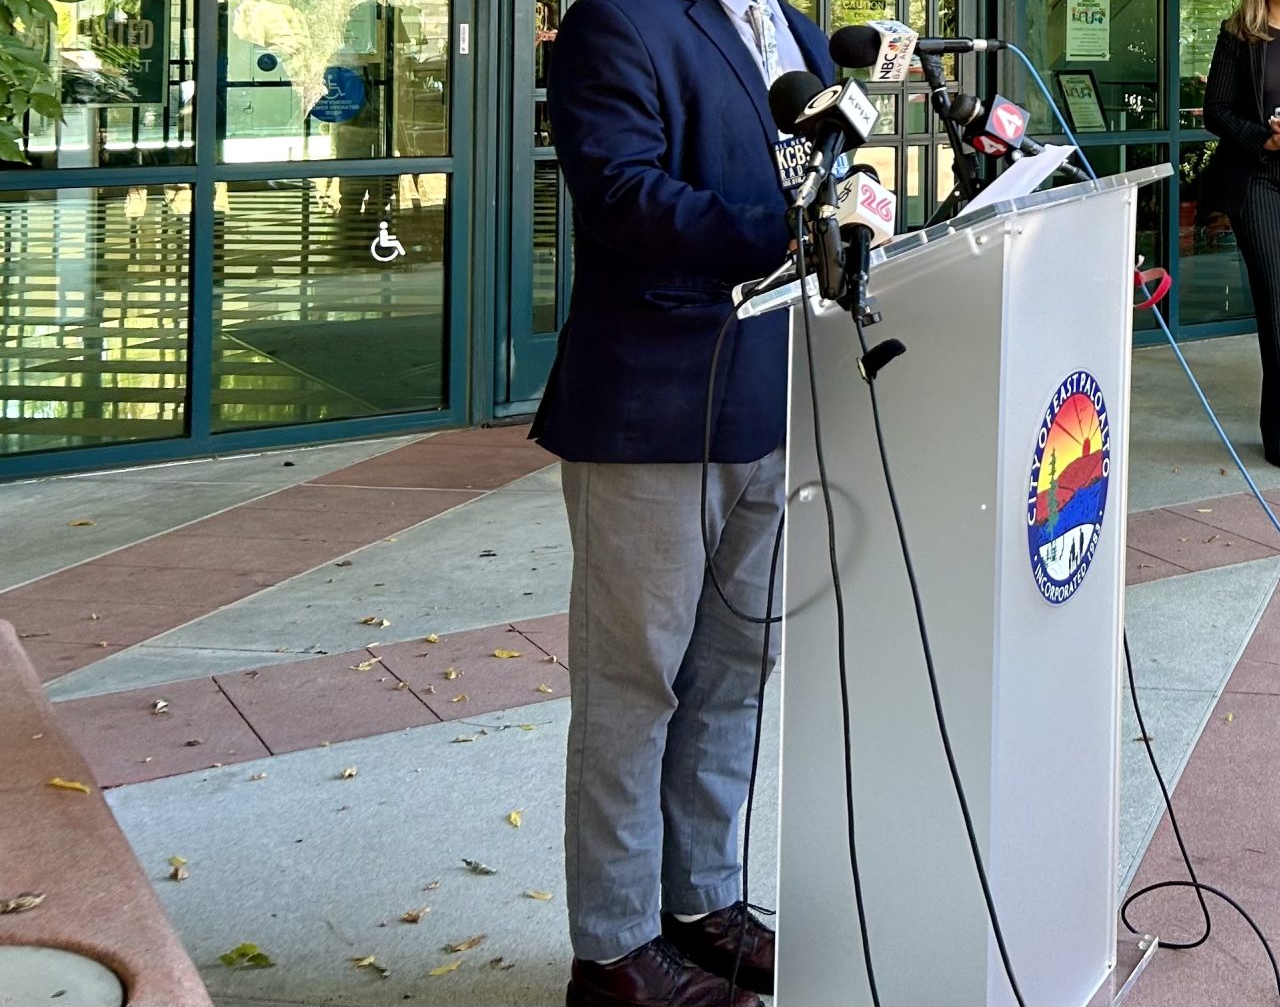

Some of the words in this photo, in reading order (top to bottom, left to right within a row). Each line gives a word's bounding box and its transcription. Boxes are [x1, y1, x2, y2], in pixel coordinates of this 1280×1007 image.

[843, 1, 884, 9] CAUTION
[880, 53, 898, 80] NBC
[892, 63, 903, 80] BAY
[900, 35, 912, 60] AREA
[848, 95, 871, 124] KPIX
[997, 106, 1023, 138] 4
[776, 141, 813, 169] KCBS
[791, 136, 806, 146] NEW
[980, 135, 1007, 154] 4
[780, 165, 804, 180] RAD
[860, 184, 893, 222] 26
[1028, 454, 1040, 525] CITY
[1038, 408, 1051, 449] OF
[1053, 373, 1079, 414] EAST
[1080, 373, 1102, 411] PALO
[1099, 411, 1110, 478] ALTO
[1034, 562, 1087, 602] INCORPORATED
